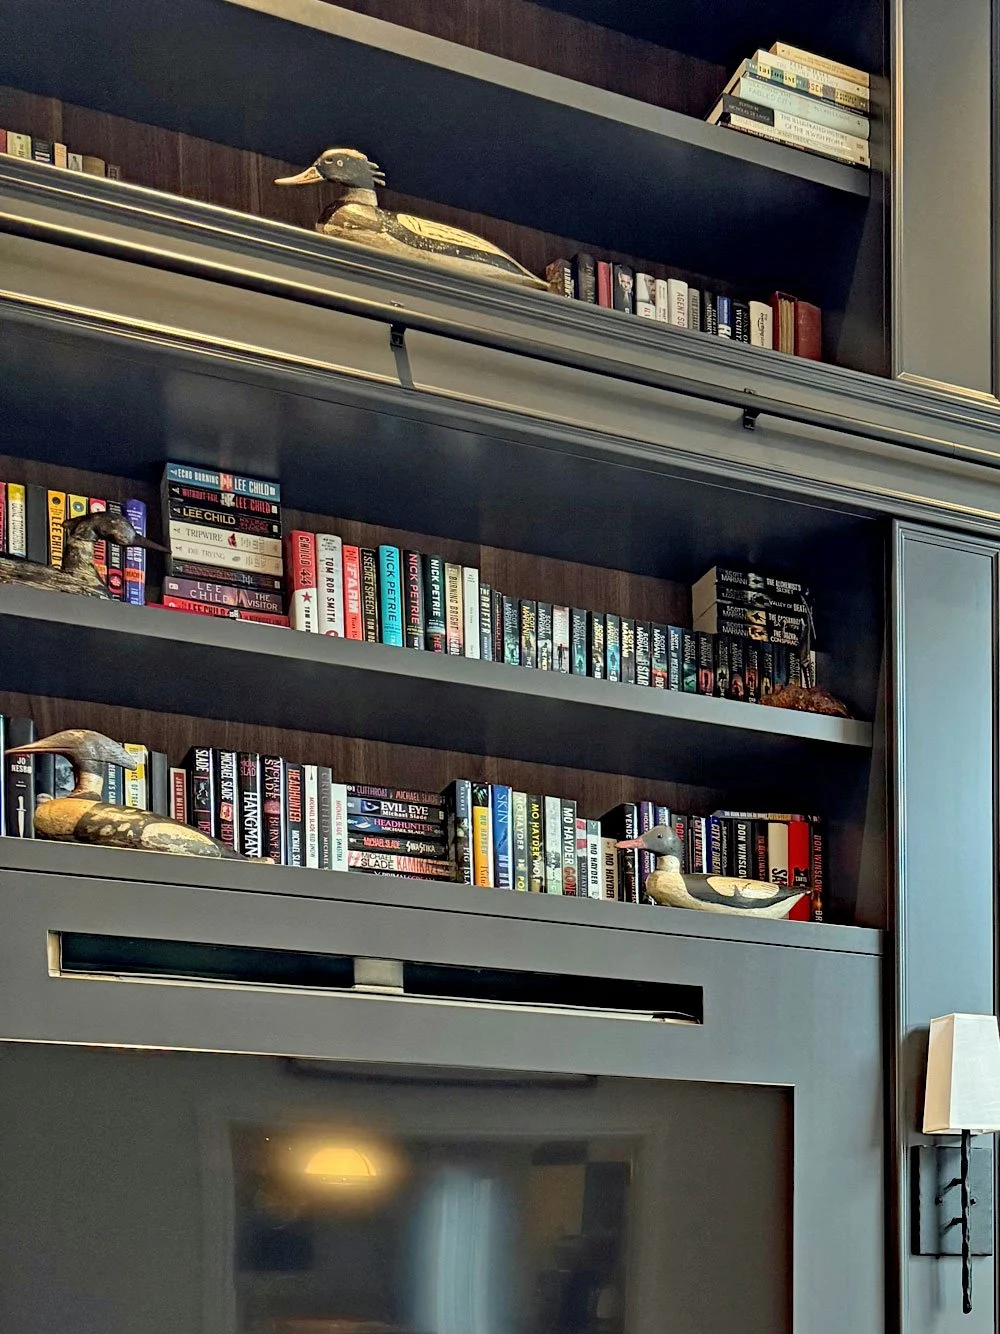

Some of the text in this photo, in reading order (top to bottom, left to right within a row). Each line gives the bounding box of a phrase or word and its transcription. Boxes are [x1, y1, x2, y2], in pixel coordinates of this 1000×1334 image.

[676, 291, 684, 315] AGENT
[177, 468, 270, 496] ECHO LEE CHILD
[183, 507, 236, 525] LEE CHILD
[235, 496, 271, 514] LEE CHILD
[51, 516, 61, 561] LEE CHILD
[186, 528, 223, 542] TRIPWIRE
[299, 535, 312, 585] CHILD 44
[197, 582, 223, 593] LEE
[325, 557, 336, 623] TOM ROB SMITH
[347, 566, 359, 614] FARM
[363, 556, 375, 615] SECRET SPEECH
[386, 550, 397, 622] NICK PETRIE
[408, 553, 420, 625] NICK PETRIE
[430, 559, 441, 617] NICK PETRIE
[721, 574, 748, 585] MARIANI
[189, 589, 230, 604] CHILD
[247, 599, 278, 611] VISITOR
[254, 592, 271, 601] THE
[448, 576, 459, 630] BURNING BRIGHT
[480, 596, 491, 634] DRIFTER
[522, 605, 530, 637] MARIANI
[573, 614, 581, 645] MARIANI
[621, 621, 629, 657] MARIANI
[636, 626, 644, 656] MARIANI
[653, 628, 661, 658] MARIANI
[722, 625, 749, 637] MARIANI
[637, 665, 649, 686] STAR
[17, 757, 26, 765] JO
[195, 749, 210, 773] SLADE
[220, 751, 233, 801] MICHAEL SLADE
[175, 776, 184, 796] JASON
[264, 758, 274, 798] SLADE
[272, 760, 281, 799] MICHAEL
[321, 772, 330, 833] CRUCIFIED
[356, 785, 420, 802] CUTTHROAT MICHAEL
[380, 801, 428, 815] EVIL EYE
[497, 793, 508, 824] SKIN
[243, 791, 258, 856] HANGMAN
[288, 768, 302, 854] HEADHUNTER MICHAEL
[335, 800, 343, 821] MICHAEL
[373, 818, 433, 832] HEADHUNTER
[382, 810, 427, 820] Michael Slade
[516, 796, 524, 850] MO HAYDER
[269, 816, 280, 849] BURNT
[381, 825, 406, 834] MICHAEL
[480, 815, 488, 855] MO HAYDER
[531, 803, 541, 883] MO HAYDER WOLF
[711, 823, 721, 850] CITY OF
[738, 824, 746, 840] DON
[361, 851, 393, 861] MICHAEL
[405, 840, 436, 853] SWASTIKA
[499, 854, 509, 867] MO
[563, 807, 576, 895] MO HAYDER GONE
[360, 857, 395, 870] SLADE
[581, 862, 587, 873] MO
[590, 843, 598, 885] MO HAYDER
[605, 853, 615, 899] MO HAYDER
[813, 835, 823, 893] DON WINSLOW
